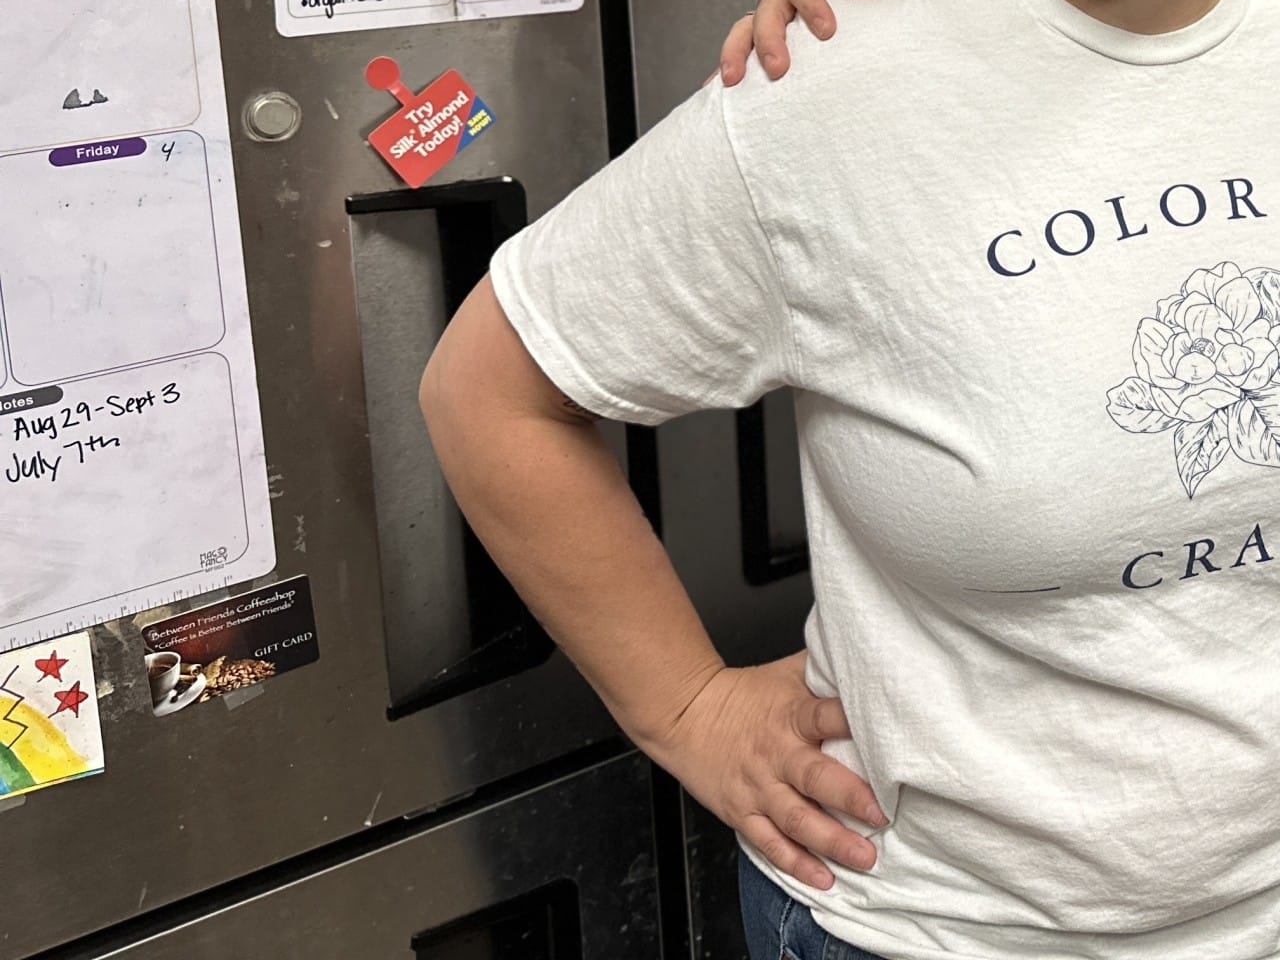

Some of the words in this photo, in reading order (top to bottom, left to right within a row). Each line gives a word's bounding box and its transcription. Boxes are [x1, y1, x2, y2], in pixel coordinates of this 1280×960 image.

[405, 101, 434, 125] Try
[417, 91, 470, 138] Almond
[467, 109, 488, 128] SAVE
[413, 115, 465, 158] Today!
[76, 143, 120, 159] Friday
[161, 140, 176, 162] 4
[986, 177, 1268, 277] COLOR
[14, 417, 57, 442] Aug
[162, 383, 180, 404] 3
[6, 453, 62, 483] July
[63, 436, 120, 464] 7th
[200, 555, 229, 568] FANCY
[151, 622, 195, 641] Between
[197, 609, 235, 627] Friends
[237, 590, 296, 614] Coffeeshop
[198, 624, 225, 638] Better
[226, 612, 261, 629] Between
[254, 643, 279, 658] GIFT
[281, 631, 313, 648] CARD
